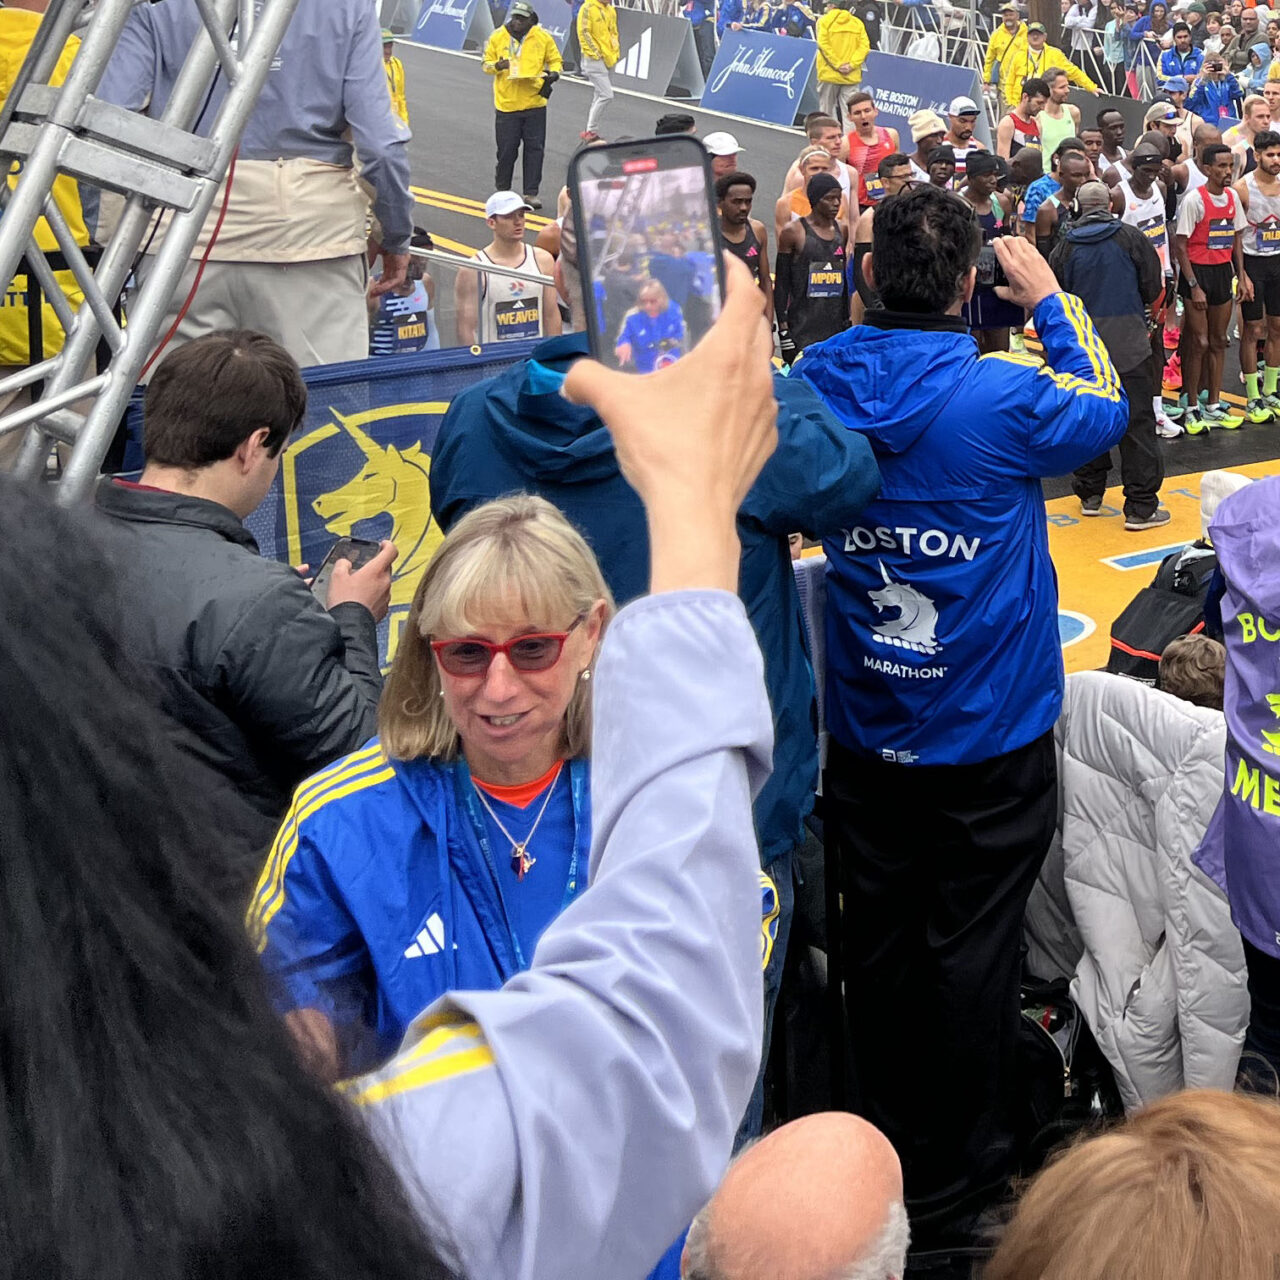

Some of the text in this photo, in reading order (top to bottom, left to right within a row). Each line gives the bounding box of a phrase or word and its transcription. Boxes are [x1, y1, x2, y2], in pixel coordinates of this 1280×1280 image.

[711, 43, 804, 99] John Hancock
[875, 88, 919, 107] THE BOSTON
[496, 309, 539, 326] WEAVER
[863, 655, 945, 680] MARATHON
